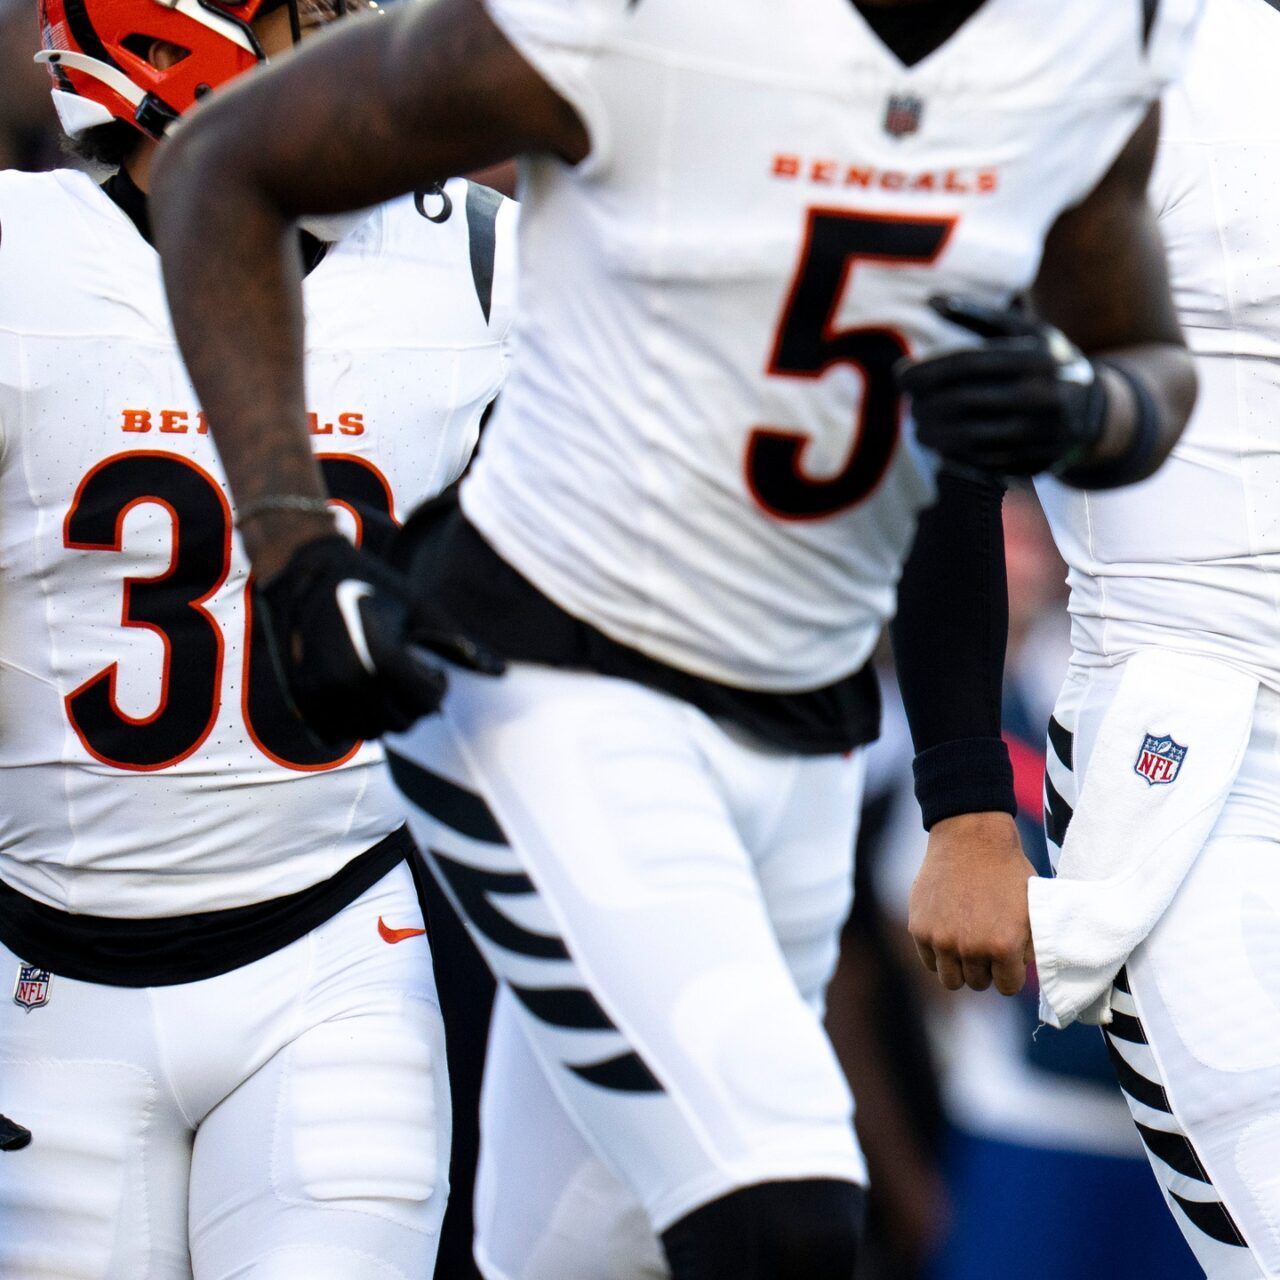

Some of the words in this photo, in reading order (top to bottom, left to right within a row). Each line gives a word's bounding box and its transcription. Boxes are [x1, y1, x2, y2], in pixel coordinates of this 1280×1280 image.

[773, 153, 999, 195] BENGALS
[743, 202, 960, 521] 5
[121, 409, 365, 436] BELS
[1138, 751, 1173, 781] NFL
[18, 982, 44, 1002] NFL
